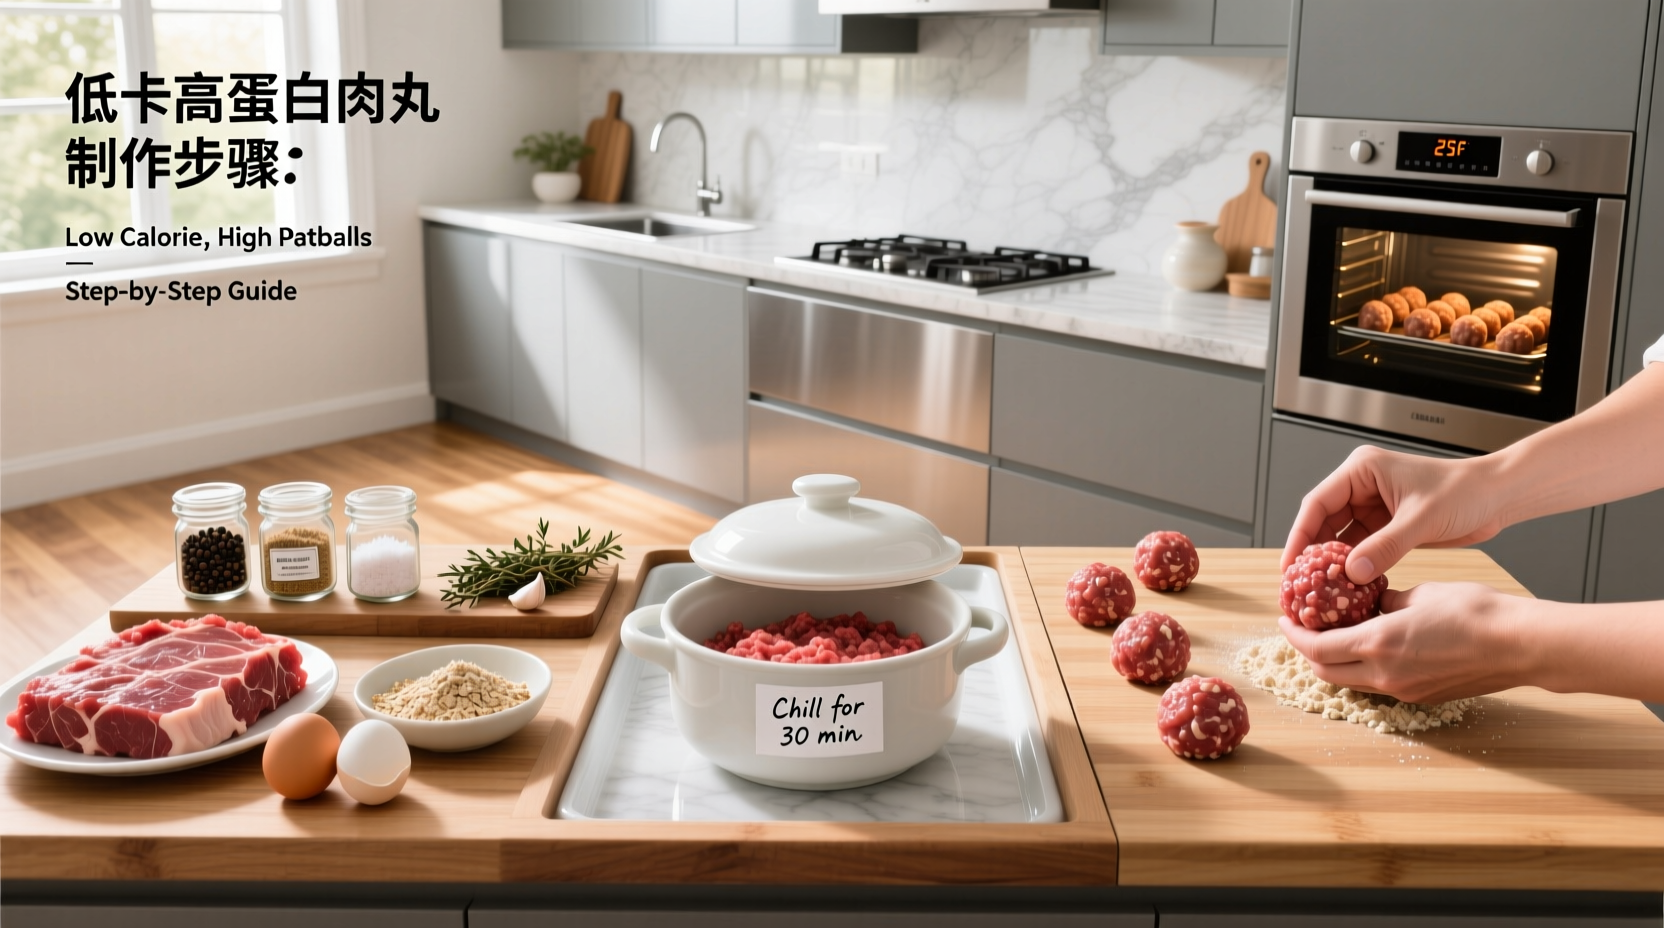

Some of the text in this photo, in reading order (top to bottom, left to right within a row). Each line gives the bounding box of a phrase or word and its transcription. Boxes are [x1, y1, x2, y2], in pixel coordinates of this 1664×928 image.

[772, 693, 865, 724] Chill for
[780, 725, 863, 747] 30 min
